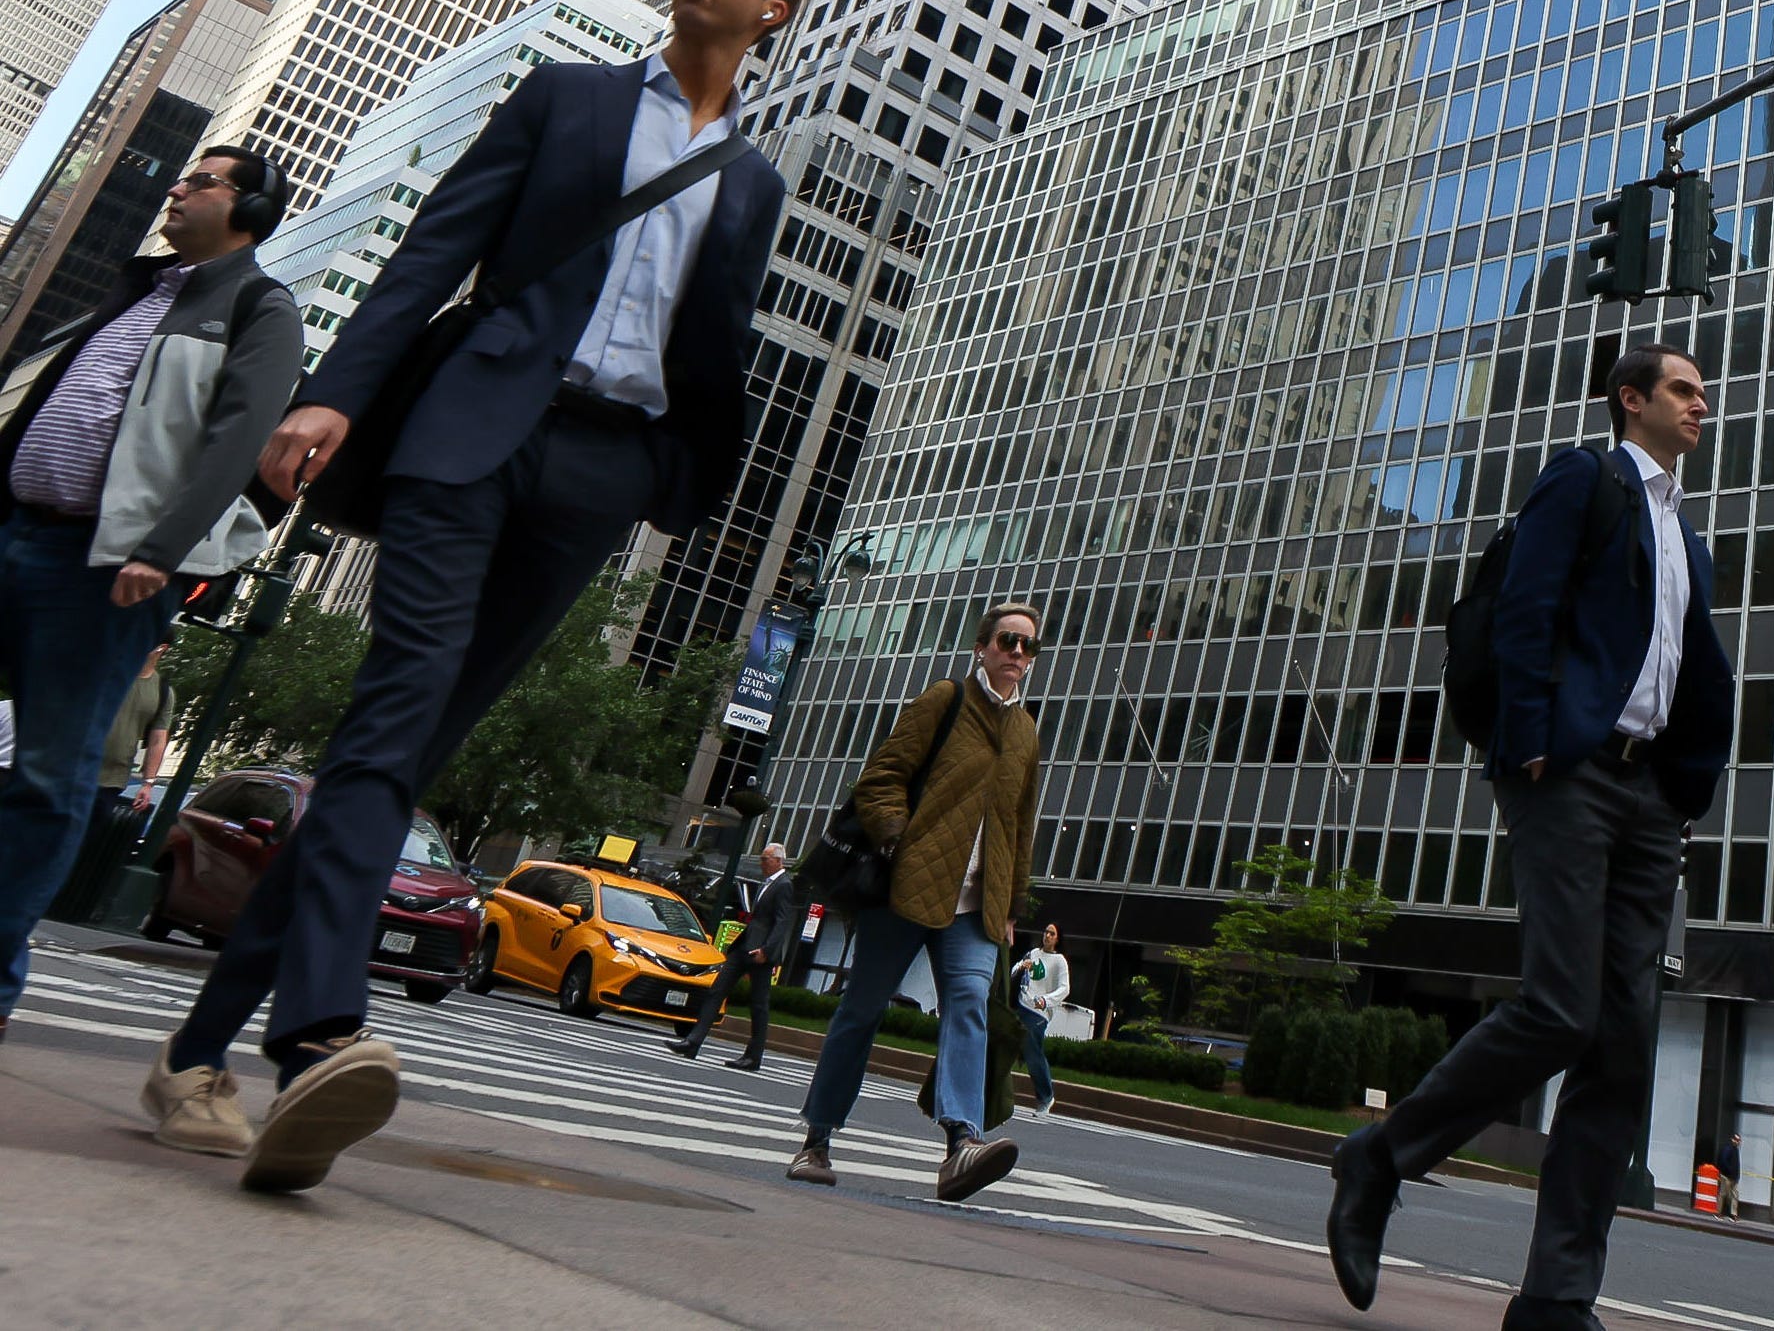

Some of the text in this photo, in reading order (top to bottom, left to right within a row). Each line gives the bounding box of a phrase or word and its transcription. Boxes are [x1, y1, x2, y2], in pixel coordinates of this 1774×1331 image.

[740, 676, 766, 690] STATE
[743, 666, 779, 685] FINANCE
[737, 684, 772, 702] OF MIND
